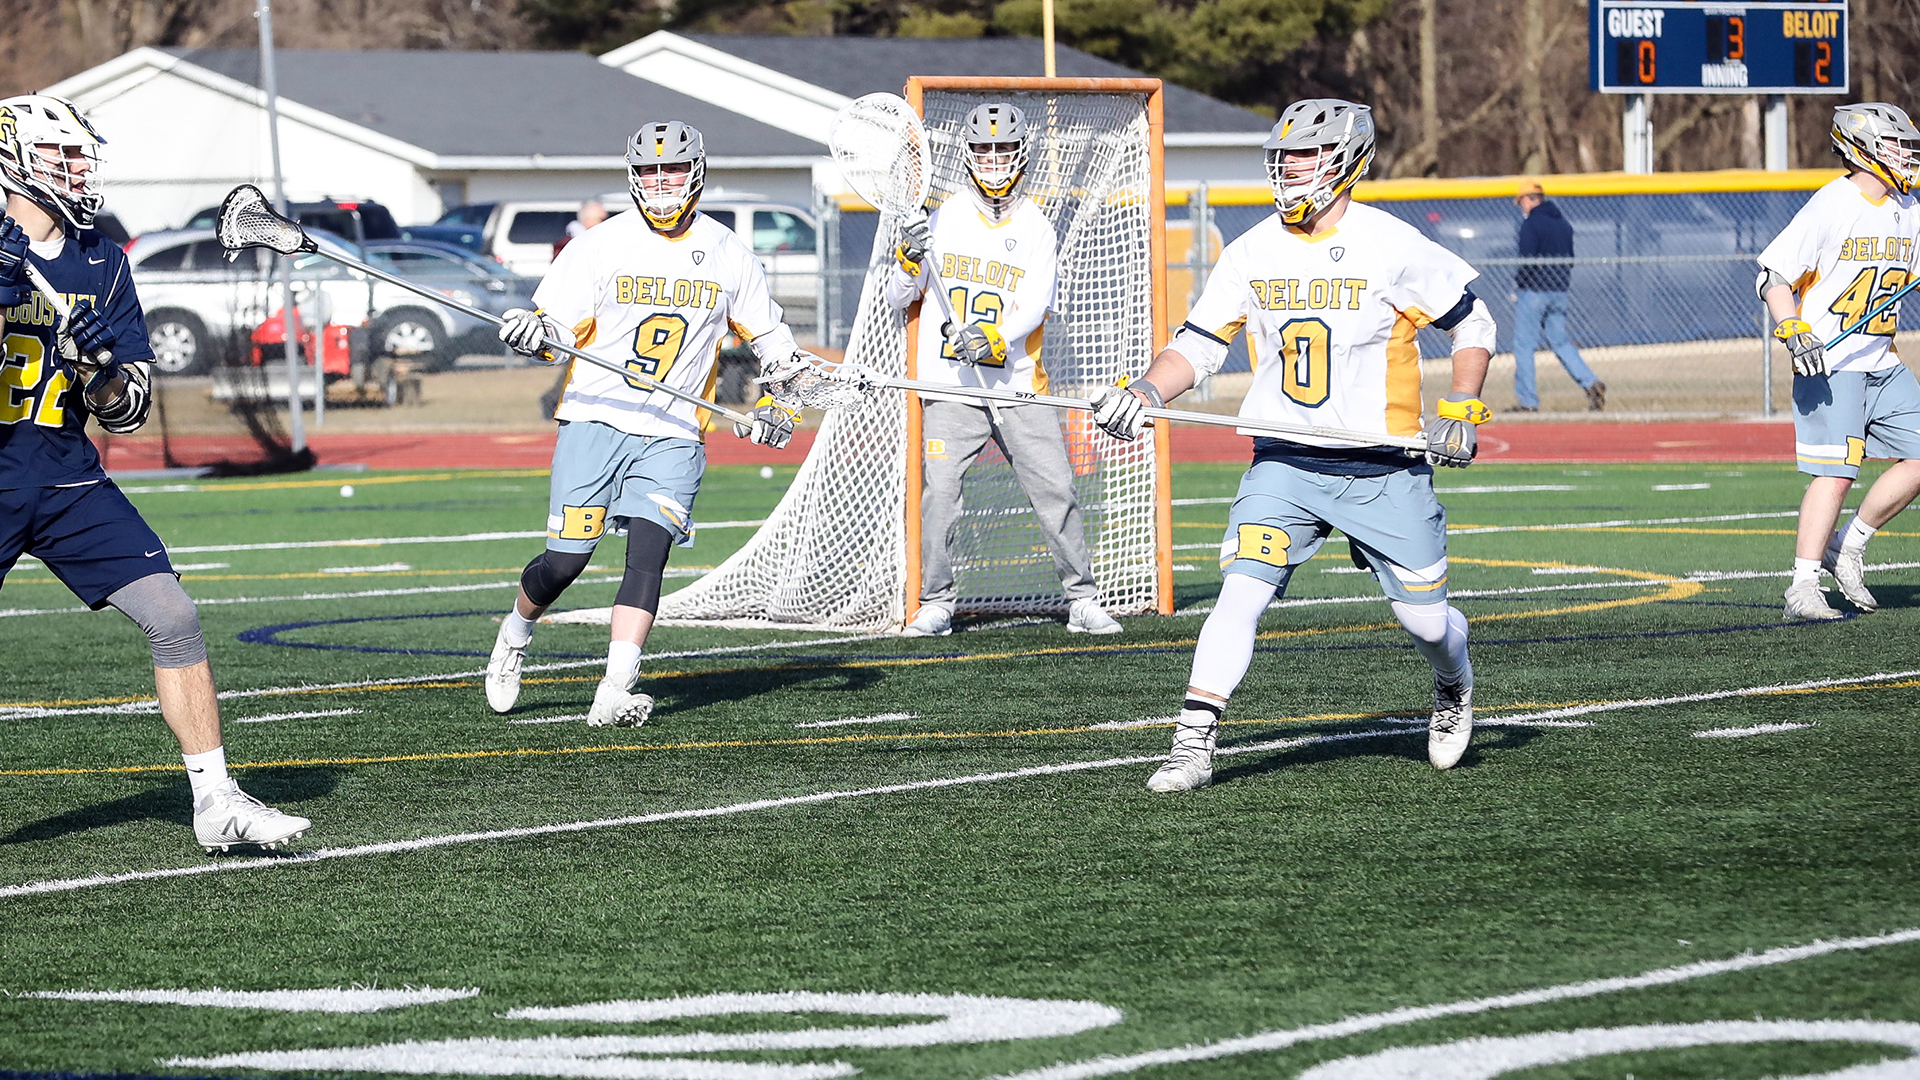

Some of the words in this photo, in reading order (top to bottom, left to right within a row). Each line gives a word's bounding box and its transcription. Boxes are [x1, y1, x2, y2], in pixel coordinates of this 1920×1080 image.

[1608, 9, 1664, 38] GUEST
[1728, 17, 1744, 59] 3
[1783, 11, 1839, 38] BELOIT
[1638, 41, 1656, 83] 0
[1701, 64, 1748, 87] INNING
[1815, 42, 1831, 83] 2
[1839, 237, 1912, 262] BELOIT
[941, 253, 1025, 292] BELOIT
[616, 275, 722, 309] BELOIT
[1250, 278, 1367, 310] BELOIT
[1828, 266, 1908, 336] 42
[623, 312, 689, 392] 9
[1278, 317, 1332, 408] 0
[1015, 391, 1037, 400] STX
[926, 438, 946, 455] B
[559, 504, 607, 540] B
[1235, 522, 1291, 568] B
